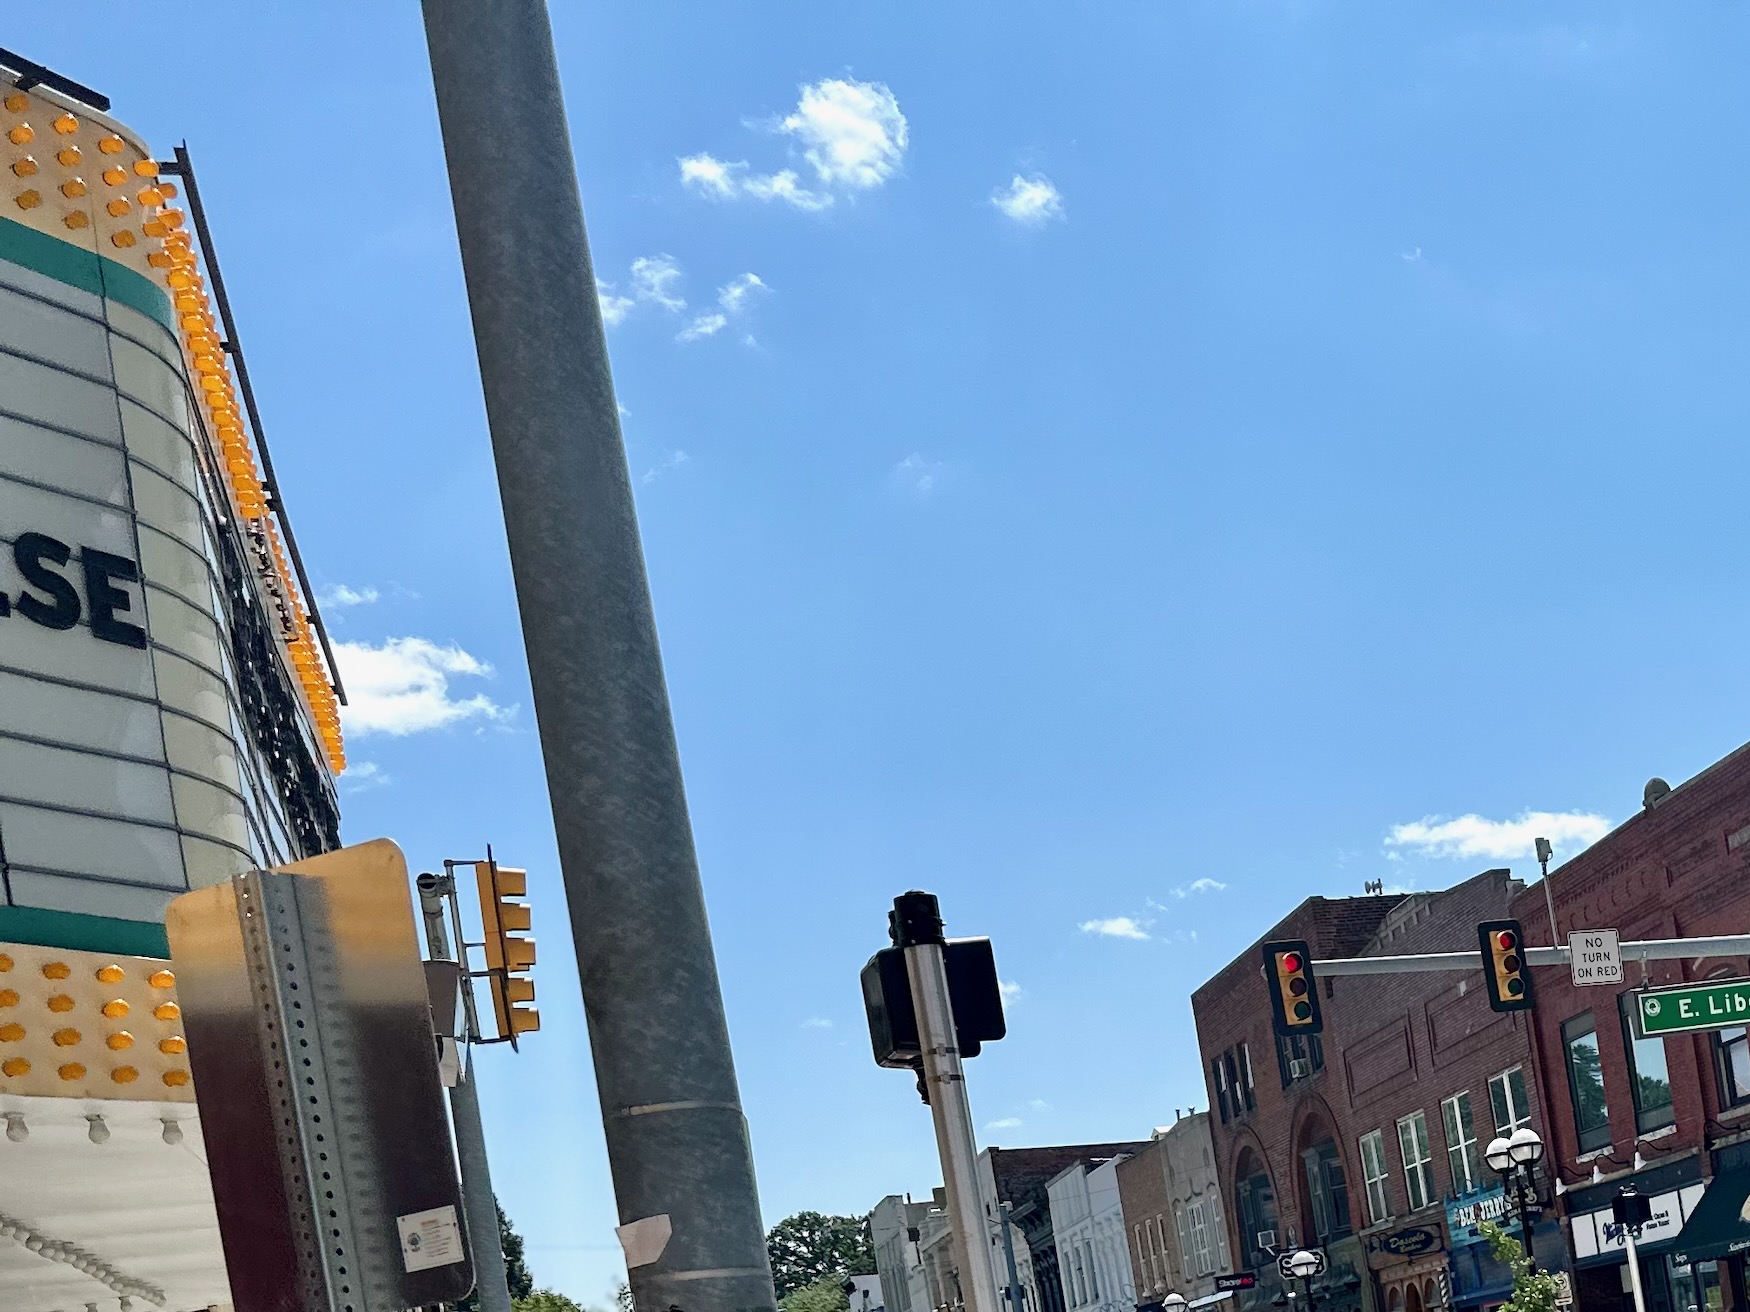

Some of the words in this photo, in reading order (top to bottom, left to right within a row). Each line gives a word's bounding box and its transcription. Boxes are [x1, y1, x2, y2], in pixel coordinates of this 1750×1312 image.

[0, 531, 147, 651] SE
[1585, 937, 1603, 948] NO
[1582, 952, 1611, 963] TURN
[1577, 966, 1593, 978] ON
[1596, 965, 1618, 977] RED
[1678, 998, 1700, 1019] E.
